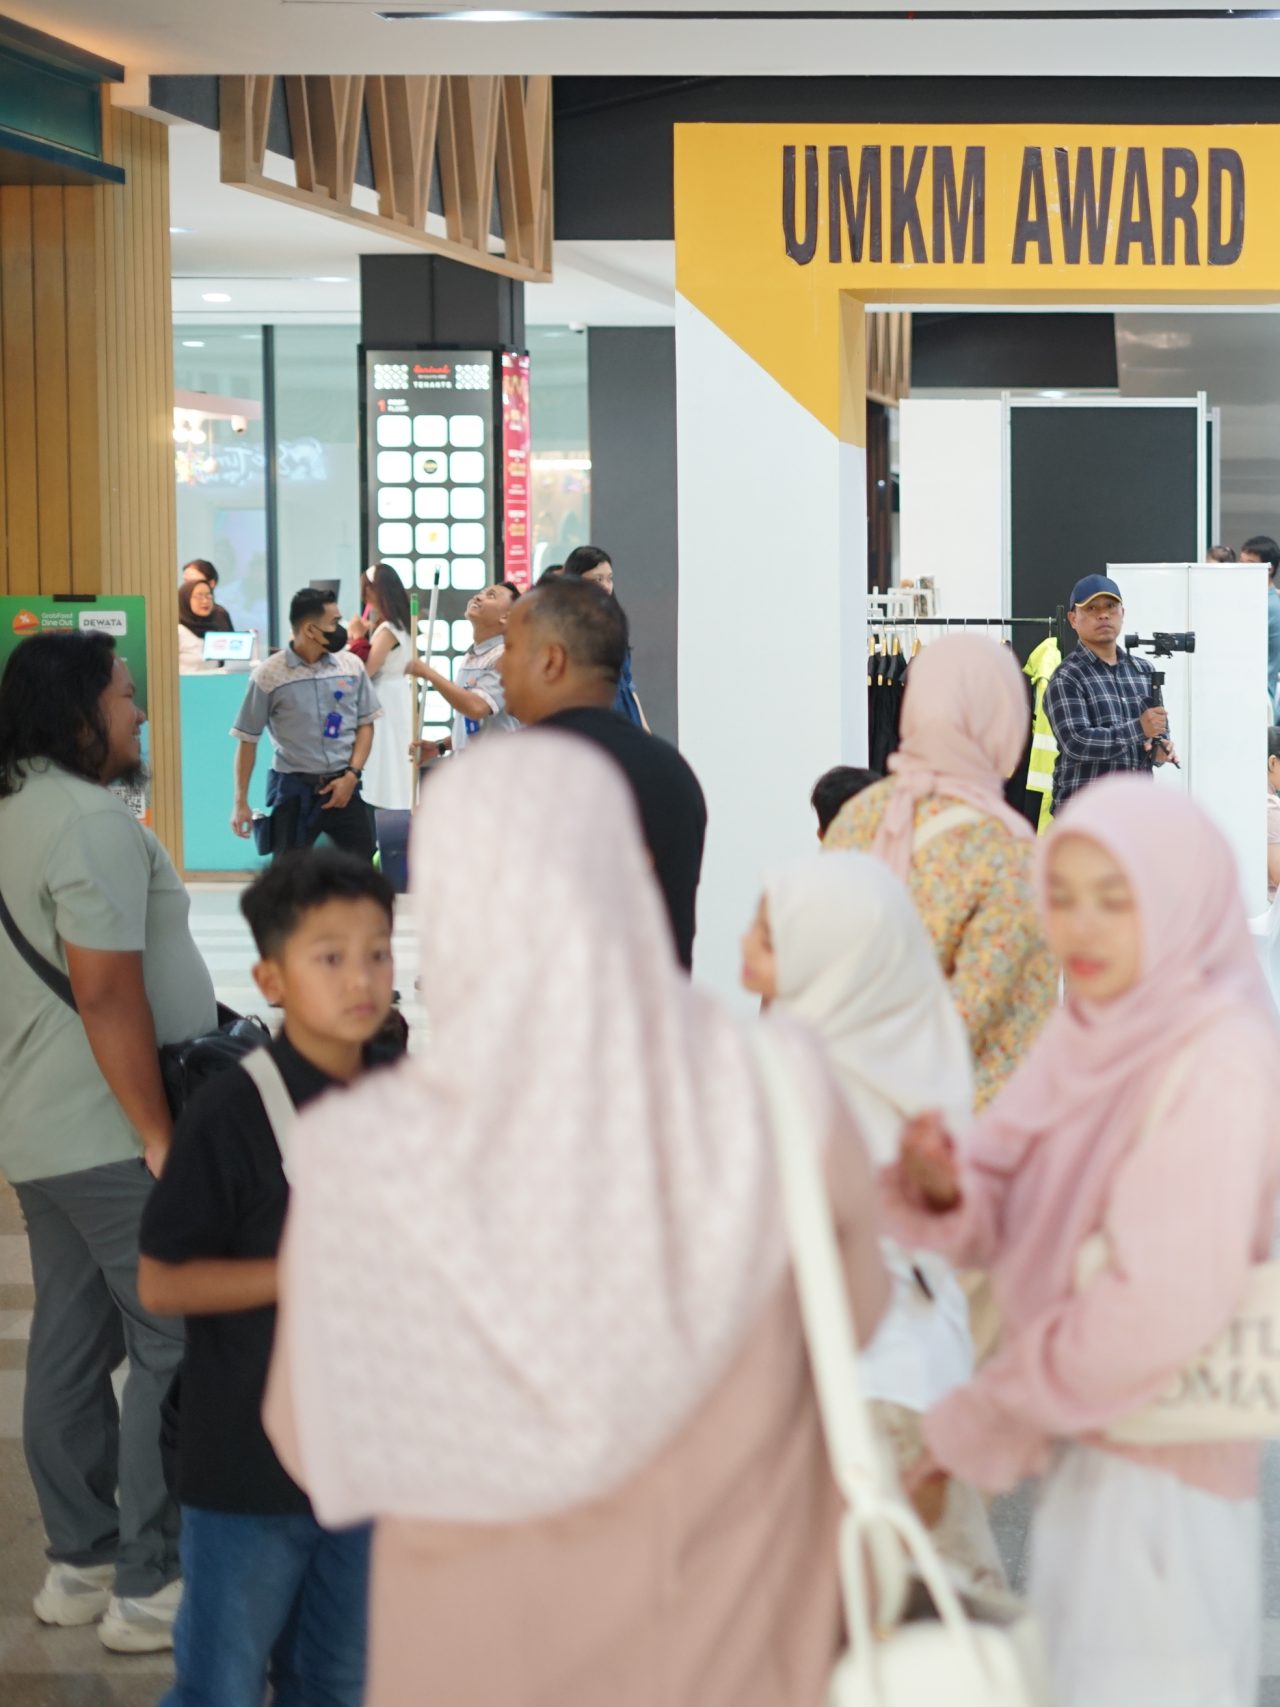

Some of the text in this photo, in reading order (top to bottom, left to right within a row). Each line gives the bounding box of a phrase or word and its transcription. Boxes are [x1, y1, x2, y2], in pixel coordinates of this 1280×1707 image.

[782, 145, 1246, 266] UMKM AWARD
[83, 618, 122, 627] DEWATA
